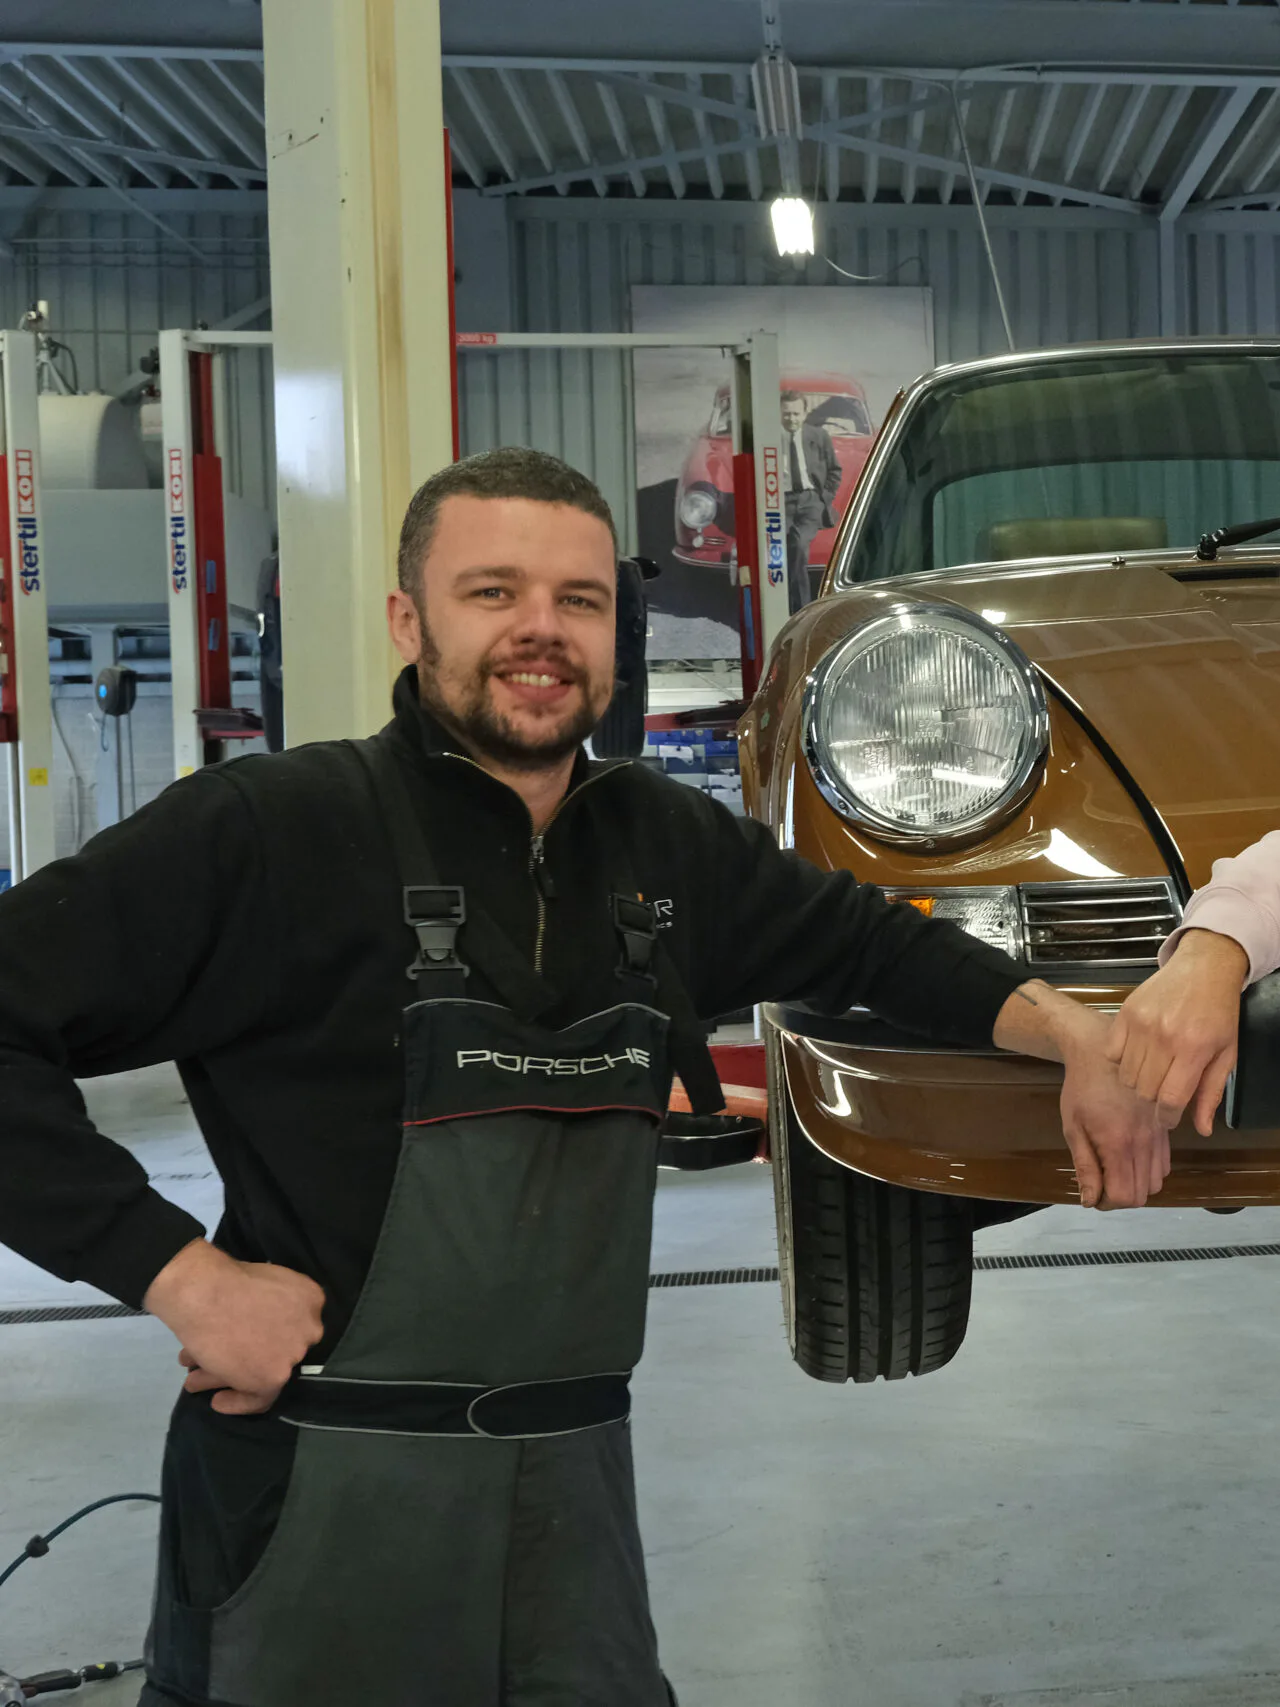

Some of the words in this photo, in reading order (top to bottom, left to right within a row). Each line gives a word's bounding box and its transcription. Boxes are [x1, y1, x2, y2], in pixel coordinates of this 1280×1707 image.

[15, 449, 34, 514] KONI
[168, 449, 184, 513] KONI
[763, 447, 779, 509] KONI
[17, 517, 40, 594] stertil
[170, 516, 187, 592] stertil
[765, 512, 783, 585] stertil
[457, 1047, 650, 1075] PORSCHE
